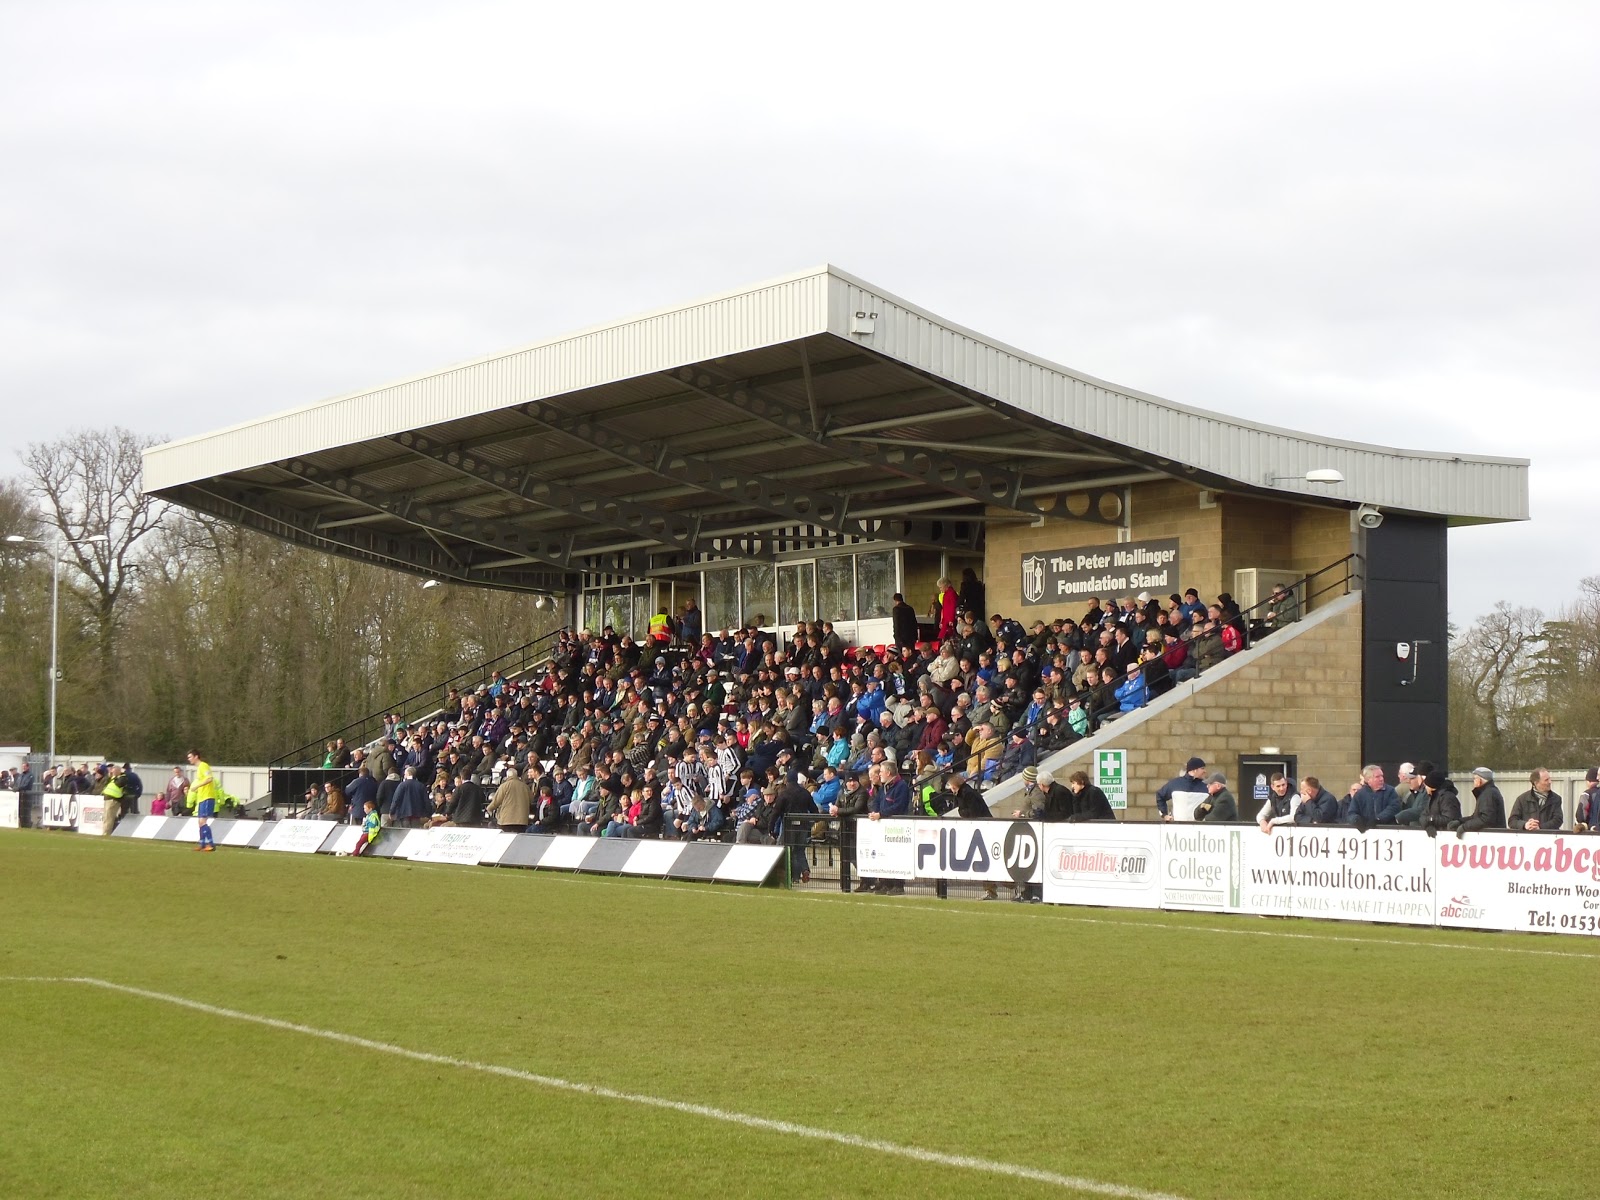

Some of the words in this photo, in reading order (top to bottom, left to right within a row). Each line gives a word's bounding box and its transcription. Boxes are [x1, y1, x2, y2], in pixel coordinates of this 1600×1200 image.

[1050, 556, 1073, 573] The
[1076, 554, 1110, 571] Peter
[1114, 548, 1175, 567] Mallinger
[1057, 574, 1126, 595] Foundation
[1130, 570, 1168, 589] Stand
[884, 826, 905, 834] Football
[884, 835, 912, 843] Foundation
[917, 827, 990, 873] FILA
[991, 842, 1001, 860] @
[1007, 834, 1036, 869] JD
[1164, 831, 1226, 853] Moulton
[1275, 835, 1330, 858] 01604
[1337, 837, 1403, 862] 491131
[1168, 857, 1222, 887] College
[1251, 864, 1433, 893] www.moulton.ac.uk
[1164, 892, 1224, 904] NORTHAMPTONSHIRE
[1507, 882, 1571, 897] Blackthorn
[1251, 894, 1270, 907] GET
[1273, 895, 1294, 908] THE
[1297, 896, 1330, 911] SKILLS
[1340, 899, 1370, 913] MAKE
[1373, 901, 1385, 914] IT
[1386, 902, 1433, 917] HAPPEN
[1528, 910, 1555, 927] Tel:
